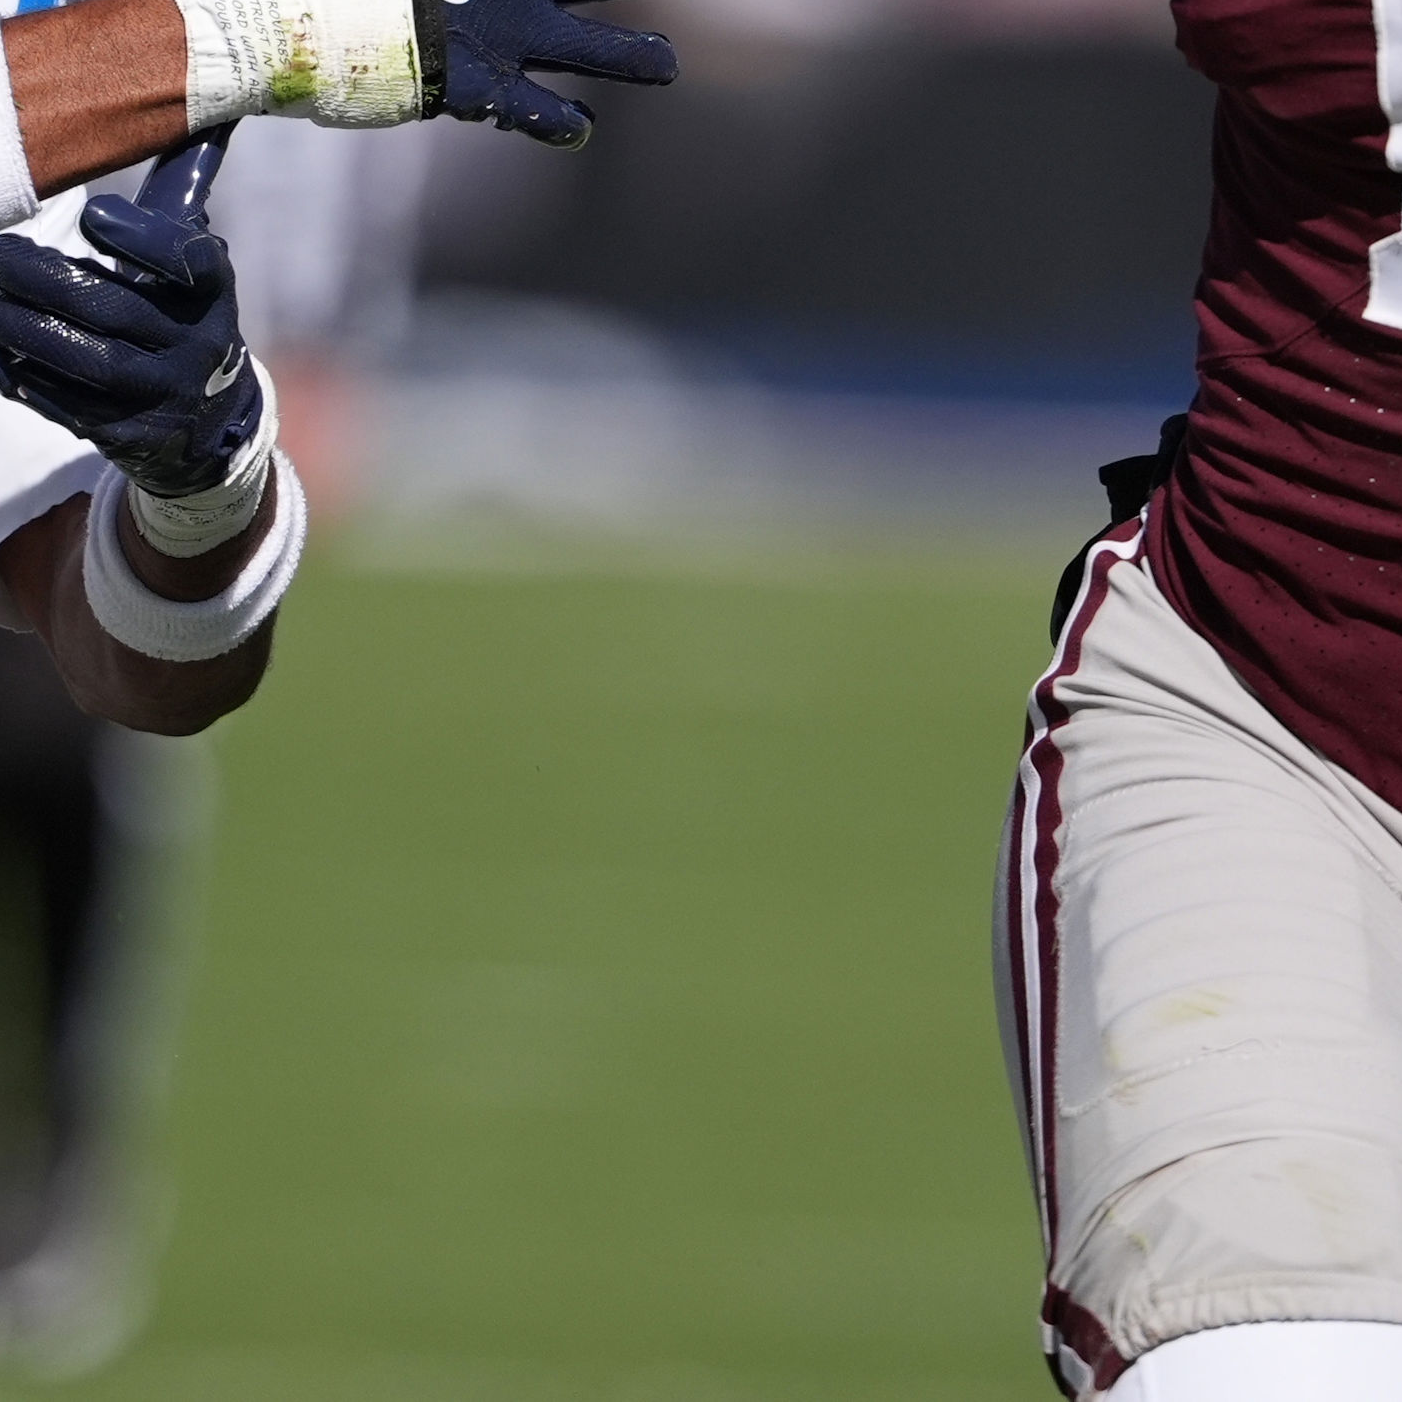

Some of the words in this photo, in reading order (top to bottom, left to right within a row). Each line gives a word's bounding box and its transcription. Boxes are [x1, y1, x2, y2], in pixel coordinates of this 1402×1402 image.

[240, 35, 259, 72] WITH
[262, 51, 274, 69] IN
[264, 75, 276, 98] THE
